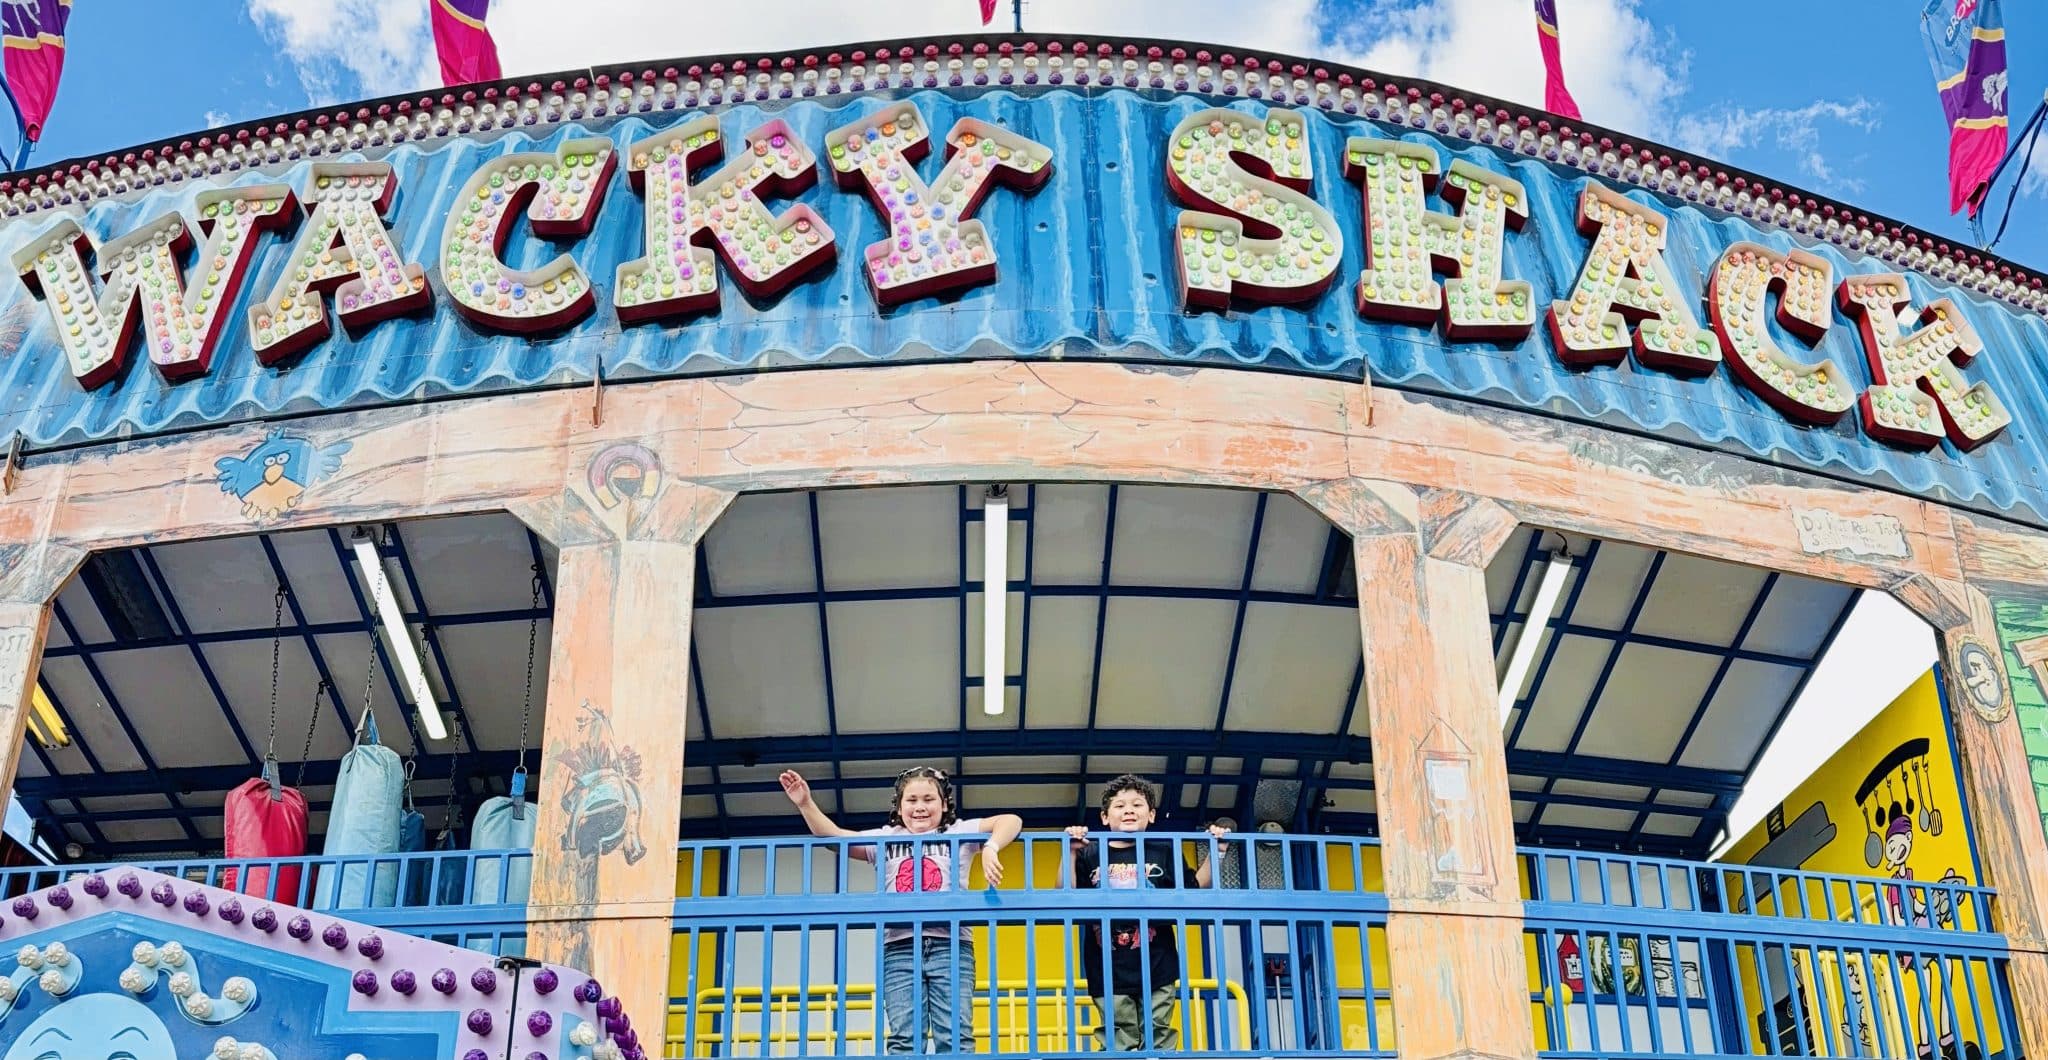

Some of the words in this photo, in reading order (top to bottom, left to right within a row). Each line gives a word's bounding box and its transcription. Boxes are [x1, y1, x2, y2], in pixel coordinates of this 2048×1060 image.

[12, 100, 1053, 390] WACKY
[1165, 107, 2013, 453] SHACK
[885, 841, 951, 859] NIRAN
